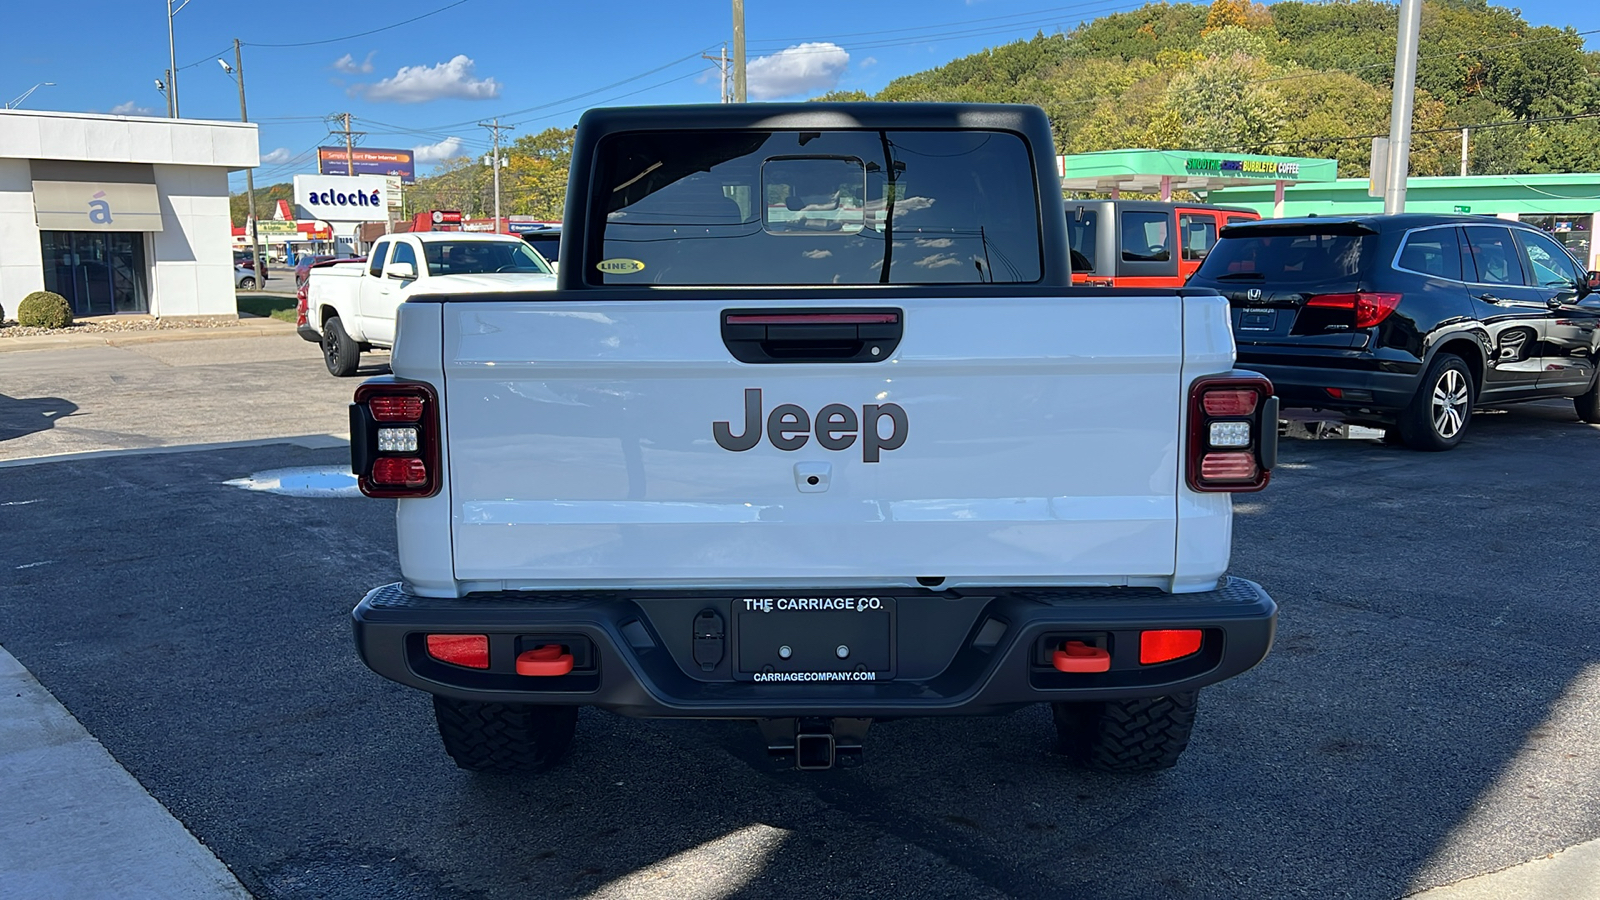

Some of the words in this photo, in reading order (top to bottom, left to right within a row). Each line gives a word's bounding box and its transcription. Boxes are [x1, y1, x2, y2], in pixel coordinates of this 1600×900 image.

[328, 152, 345, 160] Simply
[1278, 162, 1299, 174] COFFEE
[309, 189, 380, 206] acloché
[88, 190, 113, 225] á
[712, 388, 909, 463] Jeep
[743, 599, 773, 610] THE
[777, 598, 854, 610] CARRIAGE
[858, 598, 884, 610] CO.
[753, 672, 876, 682] CARRIAGECOMPANY.COM
